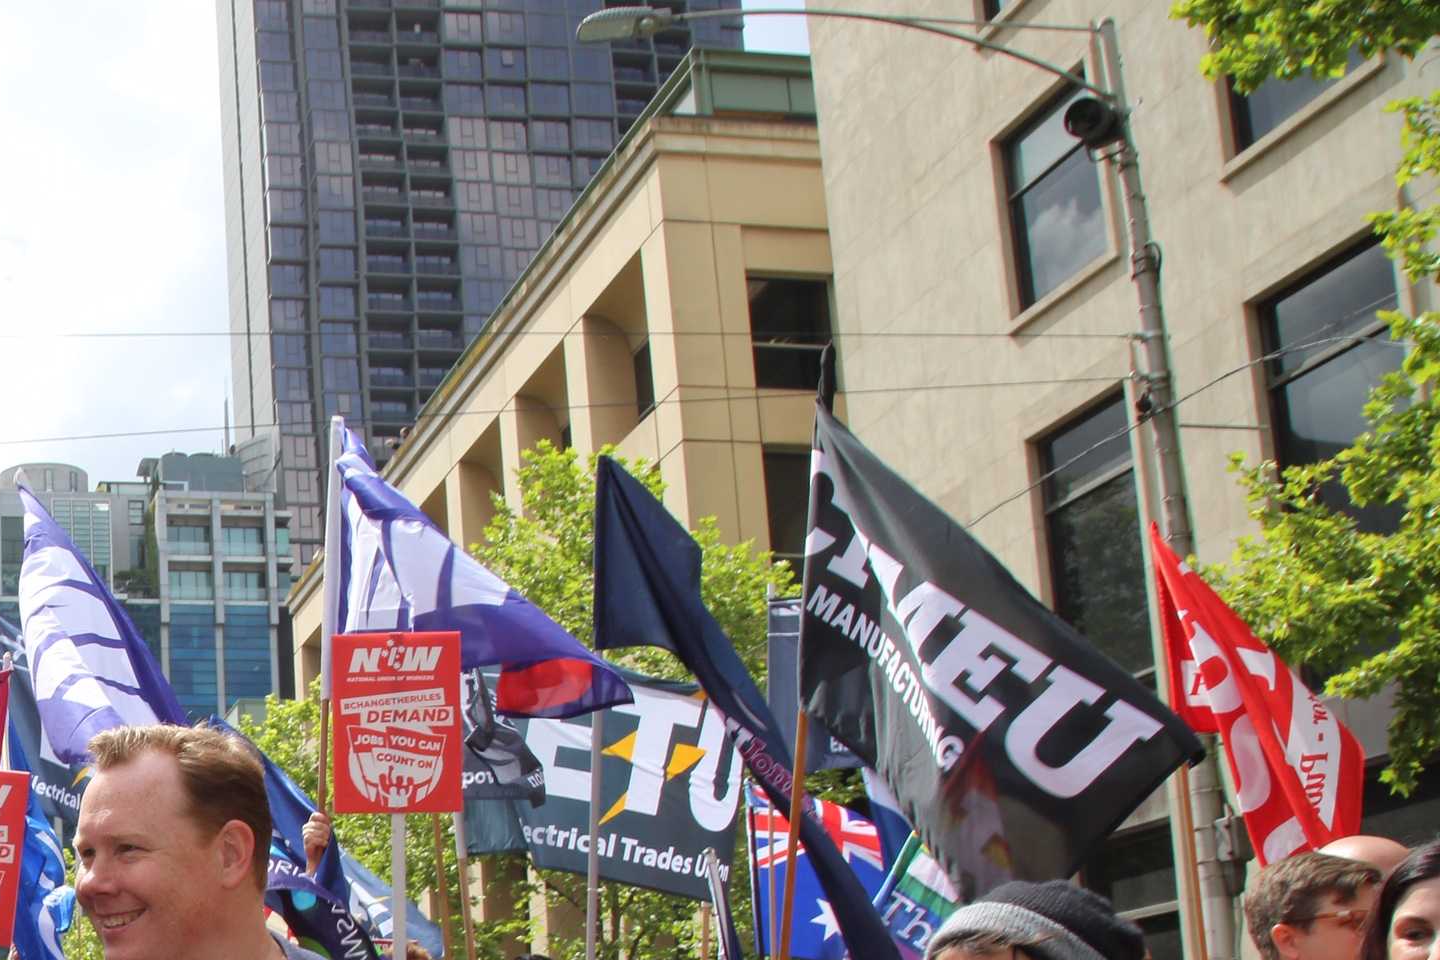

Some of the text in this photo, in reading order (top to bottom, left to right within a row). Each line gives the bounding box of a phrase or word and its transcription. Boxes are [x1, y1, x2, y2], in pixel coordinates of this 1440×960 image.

[806, 584, 965, 772] MANUFACTURING
[344, 692, 441, 711] #CHANGETHERULES
[366, 708, 450, 724] DEMAND
[389, 735, 416, 748] YOU
[418, 741, 441, 751] CAN
[376, 753, 433, 769] COUNT ON
[526, 684, 744, 832] ETU
[31, 775, 80, 810] lectrical
[522, 817, 615, 858] ectrical
[620, 836, 692, 876] Trades
